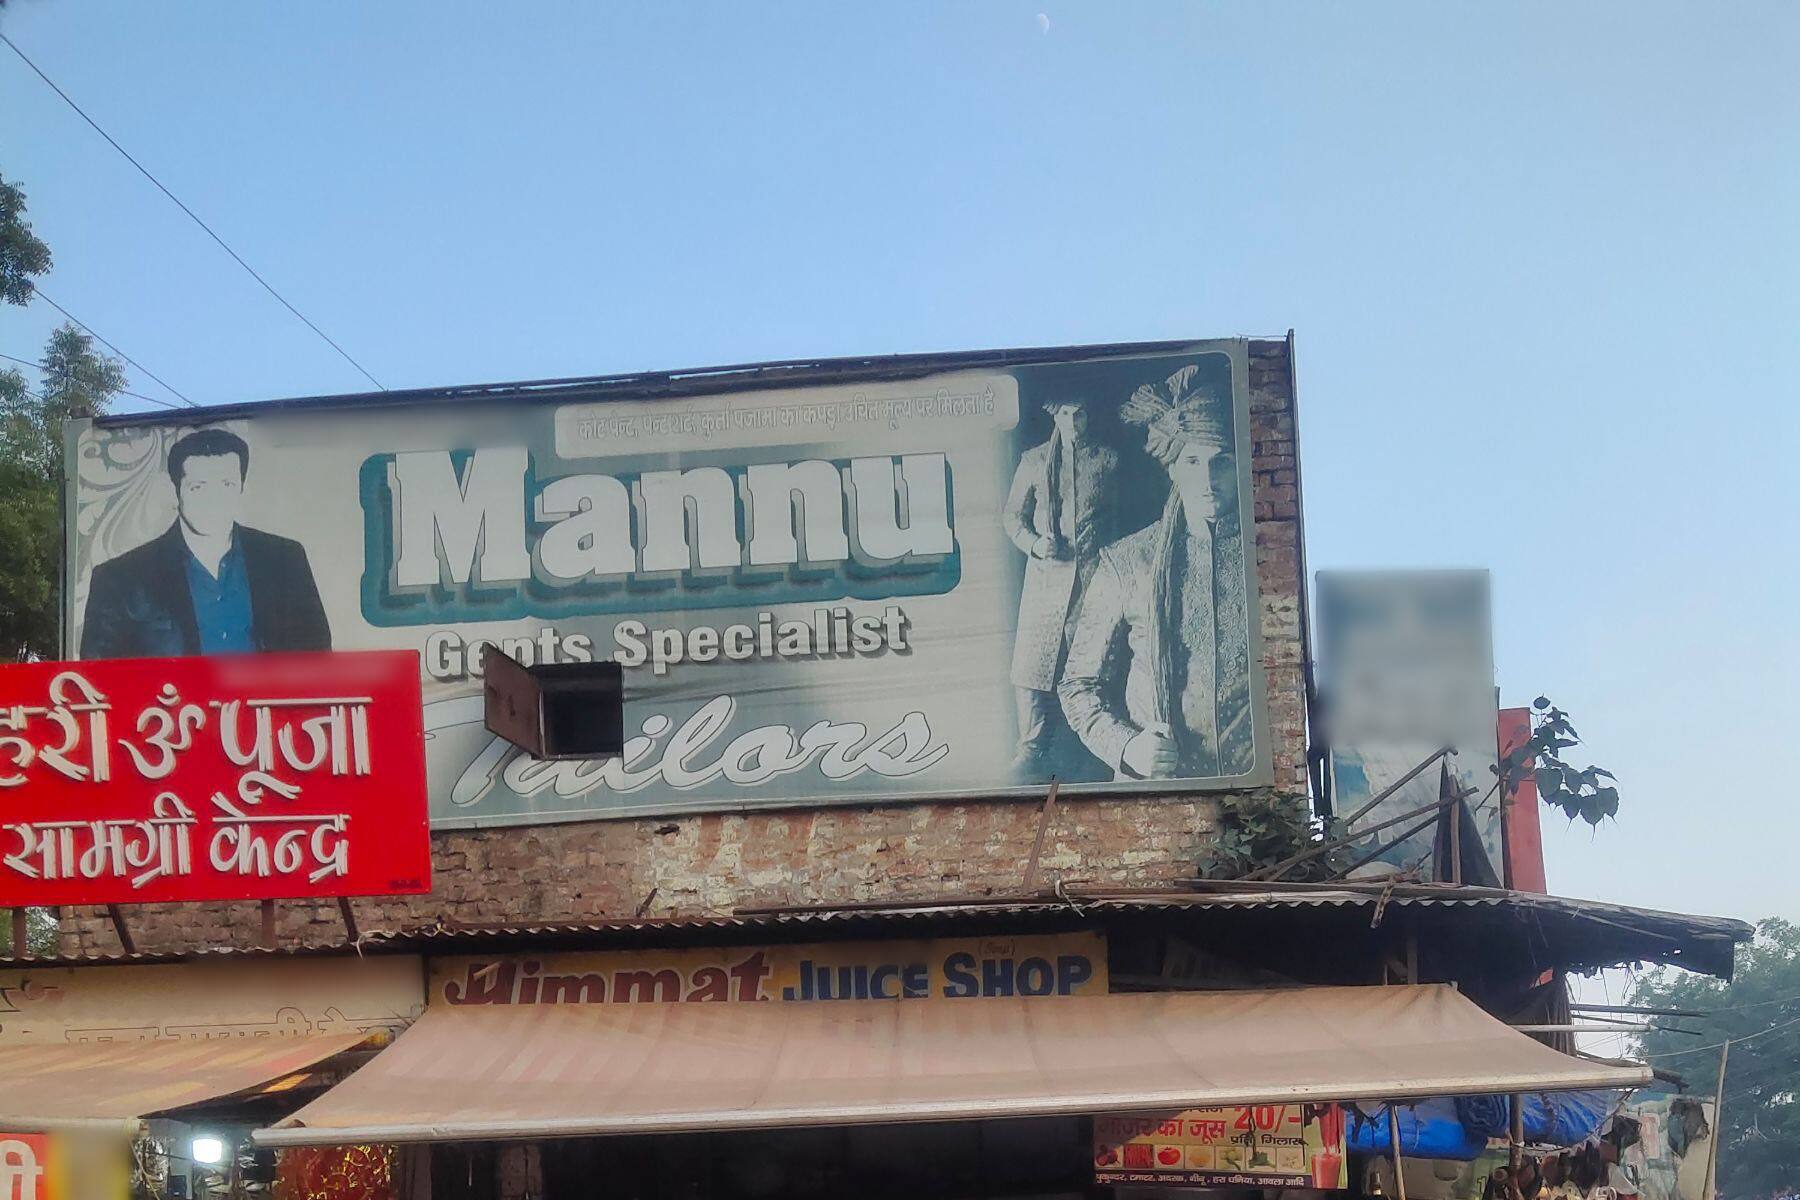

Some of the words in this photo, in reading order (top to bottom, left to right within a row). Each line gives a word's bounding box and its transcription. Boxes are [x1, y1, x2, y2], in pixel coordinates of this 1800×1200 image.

[390, 446, 954, 588] Mannu
[613, 605, 909, 674] Specialist
[209, 697, 374, 805] पूजा
[2, 792, 199, 890] सामग्री
[209, 791, 352, 885] केन्द्र
[783, 959, 929, 1000] JUICE
[943, 952, 1093, 998] SHOP
[1157, 1117, 1184, 1138] का
[1188, 1119, 1227, 1145] जूस
